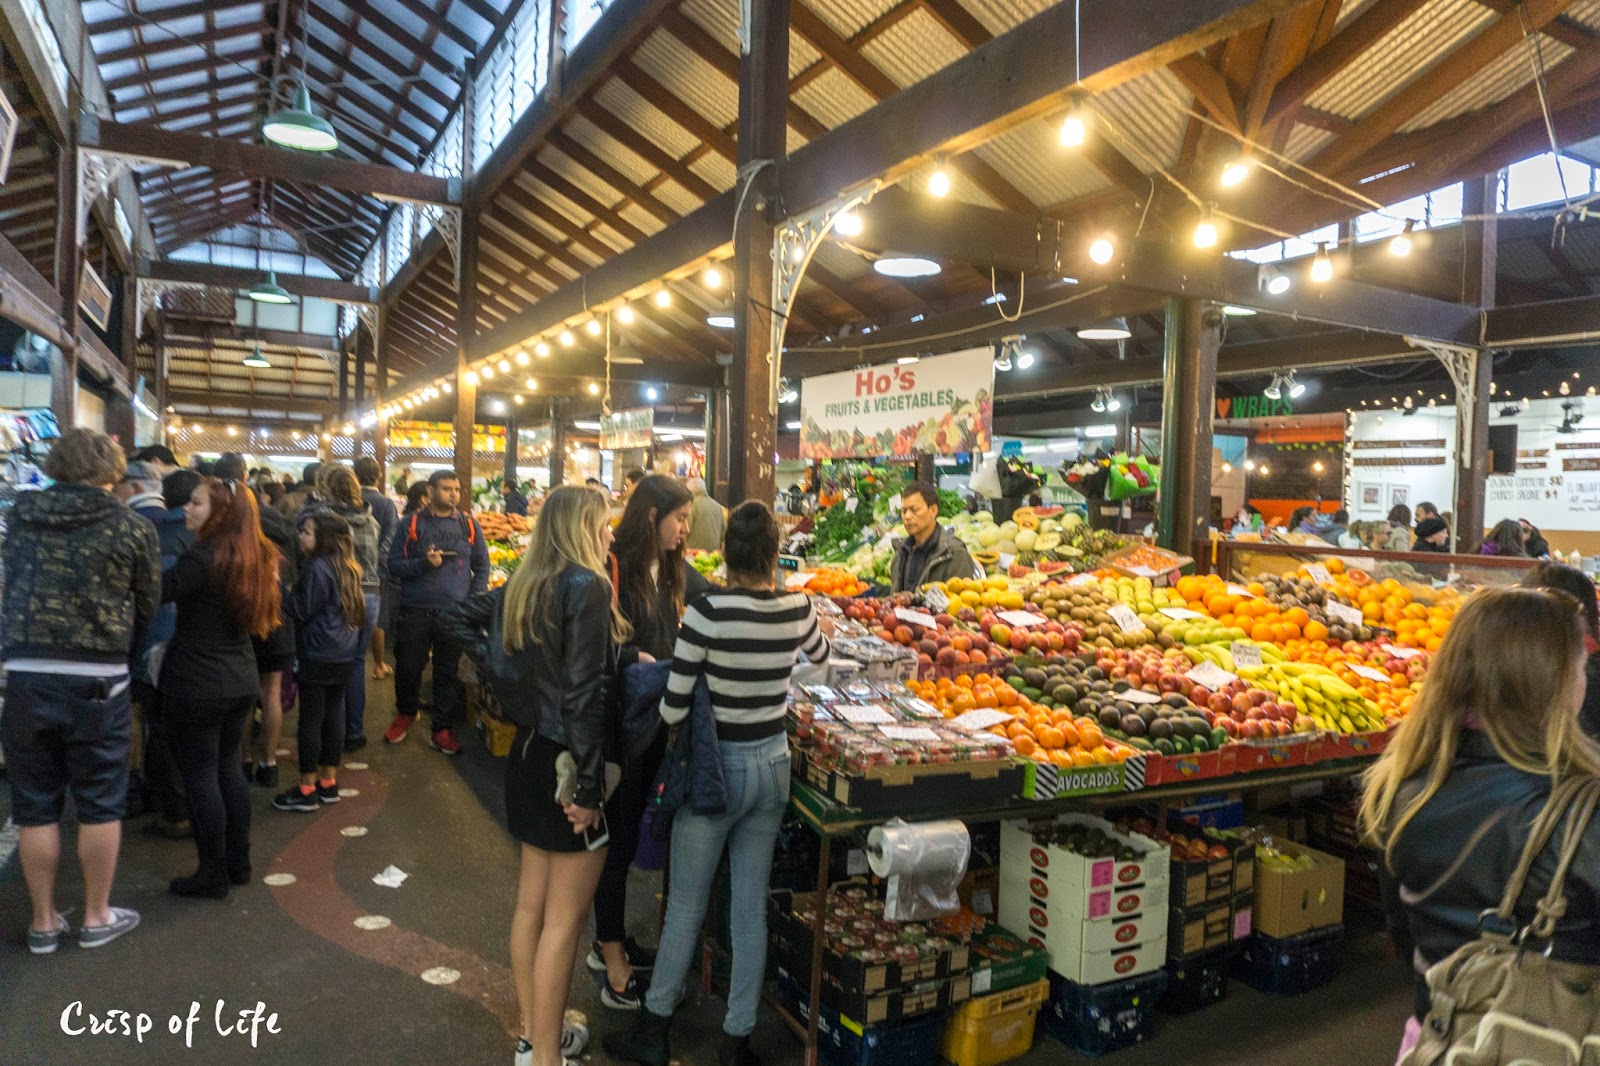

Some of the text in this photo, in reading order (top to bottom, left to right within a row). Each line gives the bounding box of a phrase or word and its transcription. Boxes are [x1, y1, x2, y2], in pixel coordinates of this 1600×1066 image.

[855, 366, 916, 397] Ho's
[825, 389, 955, 419] FRUITS & VEGETABLES
[1232, 394, 1294, 418] WRAPS
[1056, 771, 1121, 791] AVOCADOS
